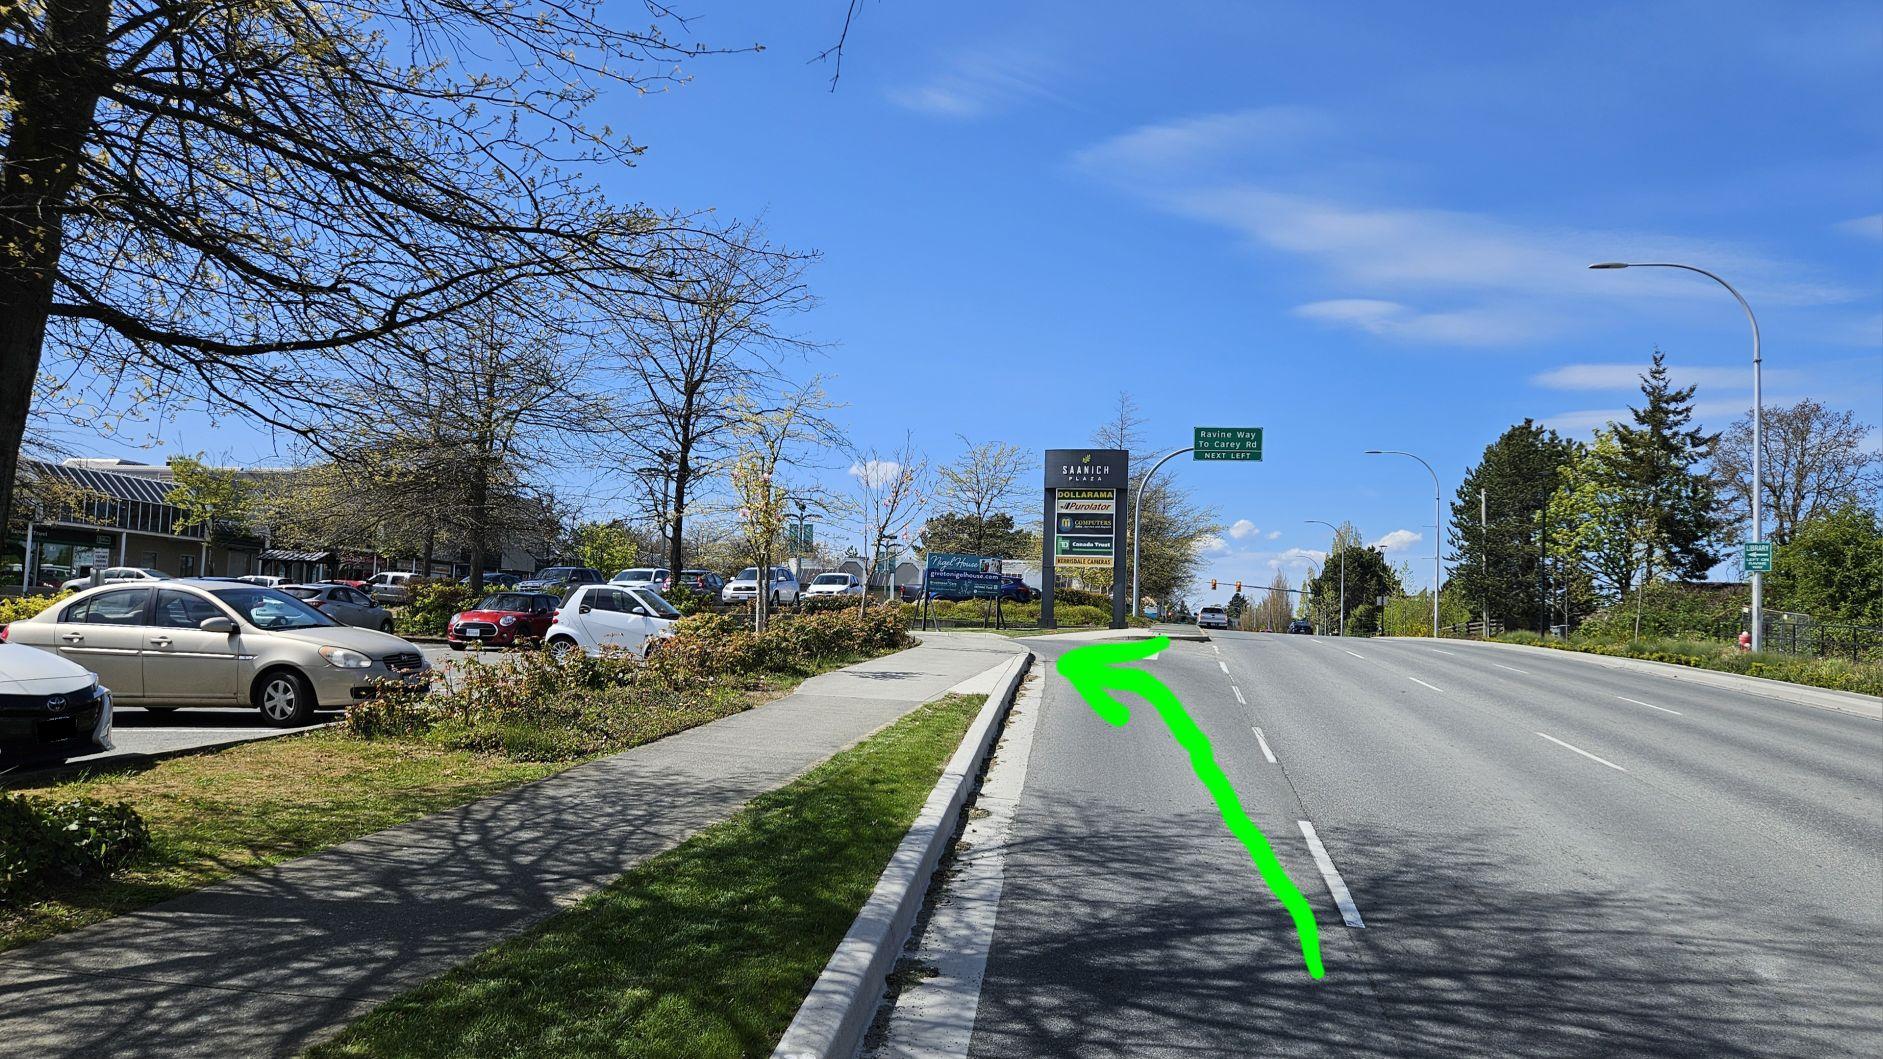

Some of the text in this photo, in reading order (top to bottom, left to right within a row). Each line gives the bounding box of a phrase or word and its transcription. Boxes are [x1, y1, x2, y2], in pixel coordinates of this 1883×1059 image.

[1200, 430, 1256, 440] Ravine Way
[1198, 440, 1257, 449] To Carey Rd
[1062, 465, 1109, 475] SAANICH
[1058, 491, 1113, 499] DOLLARAMA
[1069, 502, 1111, 511] Purolator
[930, 555, 979, 571] Nigel House
[930, 570, 999, 580] givetonigelhouse.com
